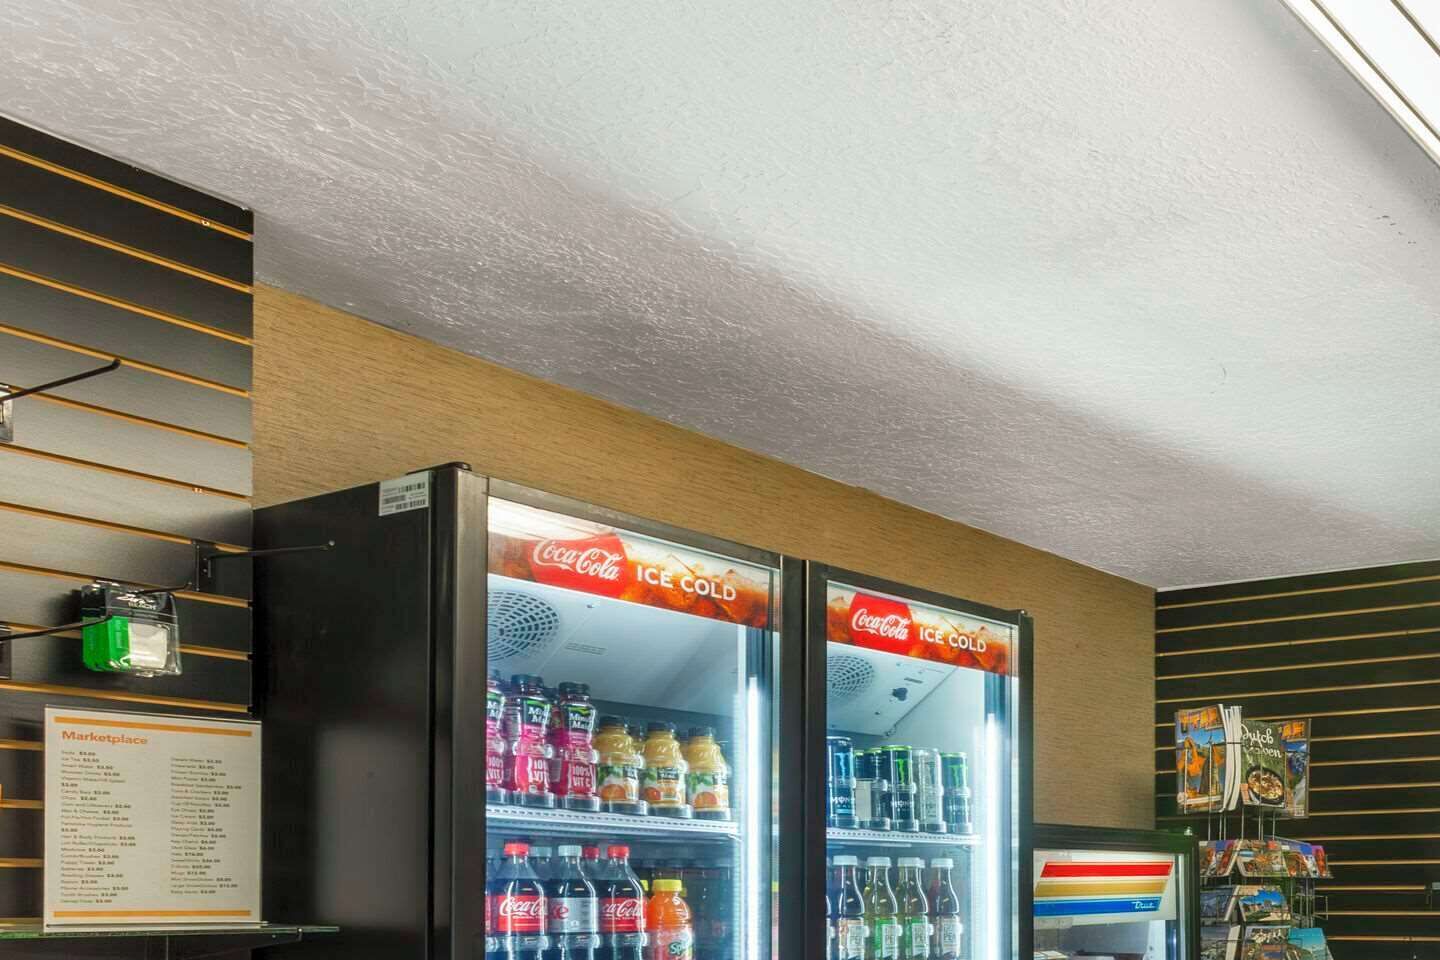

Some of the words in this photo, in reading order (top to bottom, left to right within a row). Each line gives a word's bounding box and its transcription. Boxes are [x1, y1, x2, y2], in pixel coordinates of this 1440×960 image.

[532, 539, 624, 581] Coca-Cola
[636, 564, 673, 588] ICE
[680, 574, 737, 601] COLD
[851, 607, 911, 641] Coca-Cola
[919, 626, 944, 643] ICE
[948, 633, 987, 653] COLD
[62, 731, 148, 745] Marketplace
